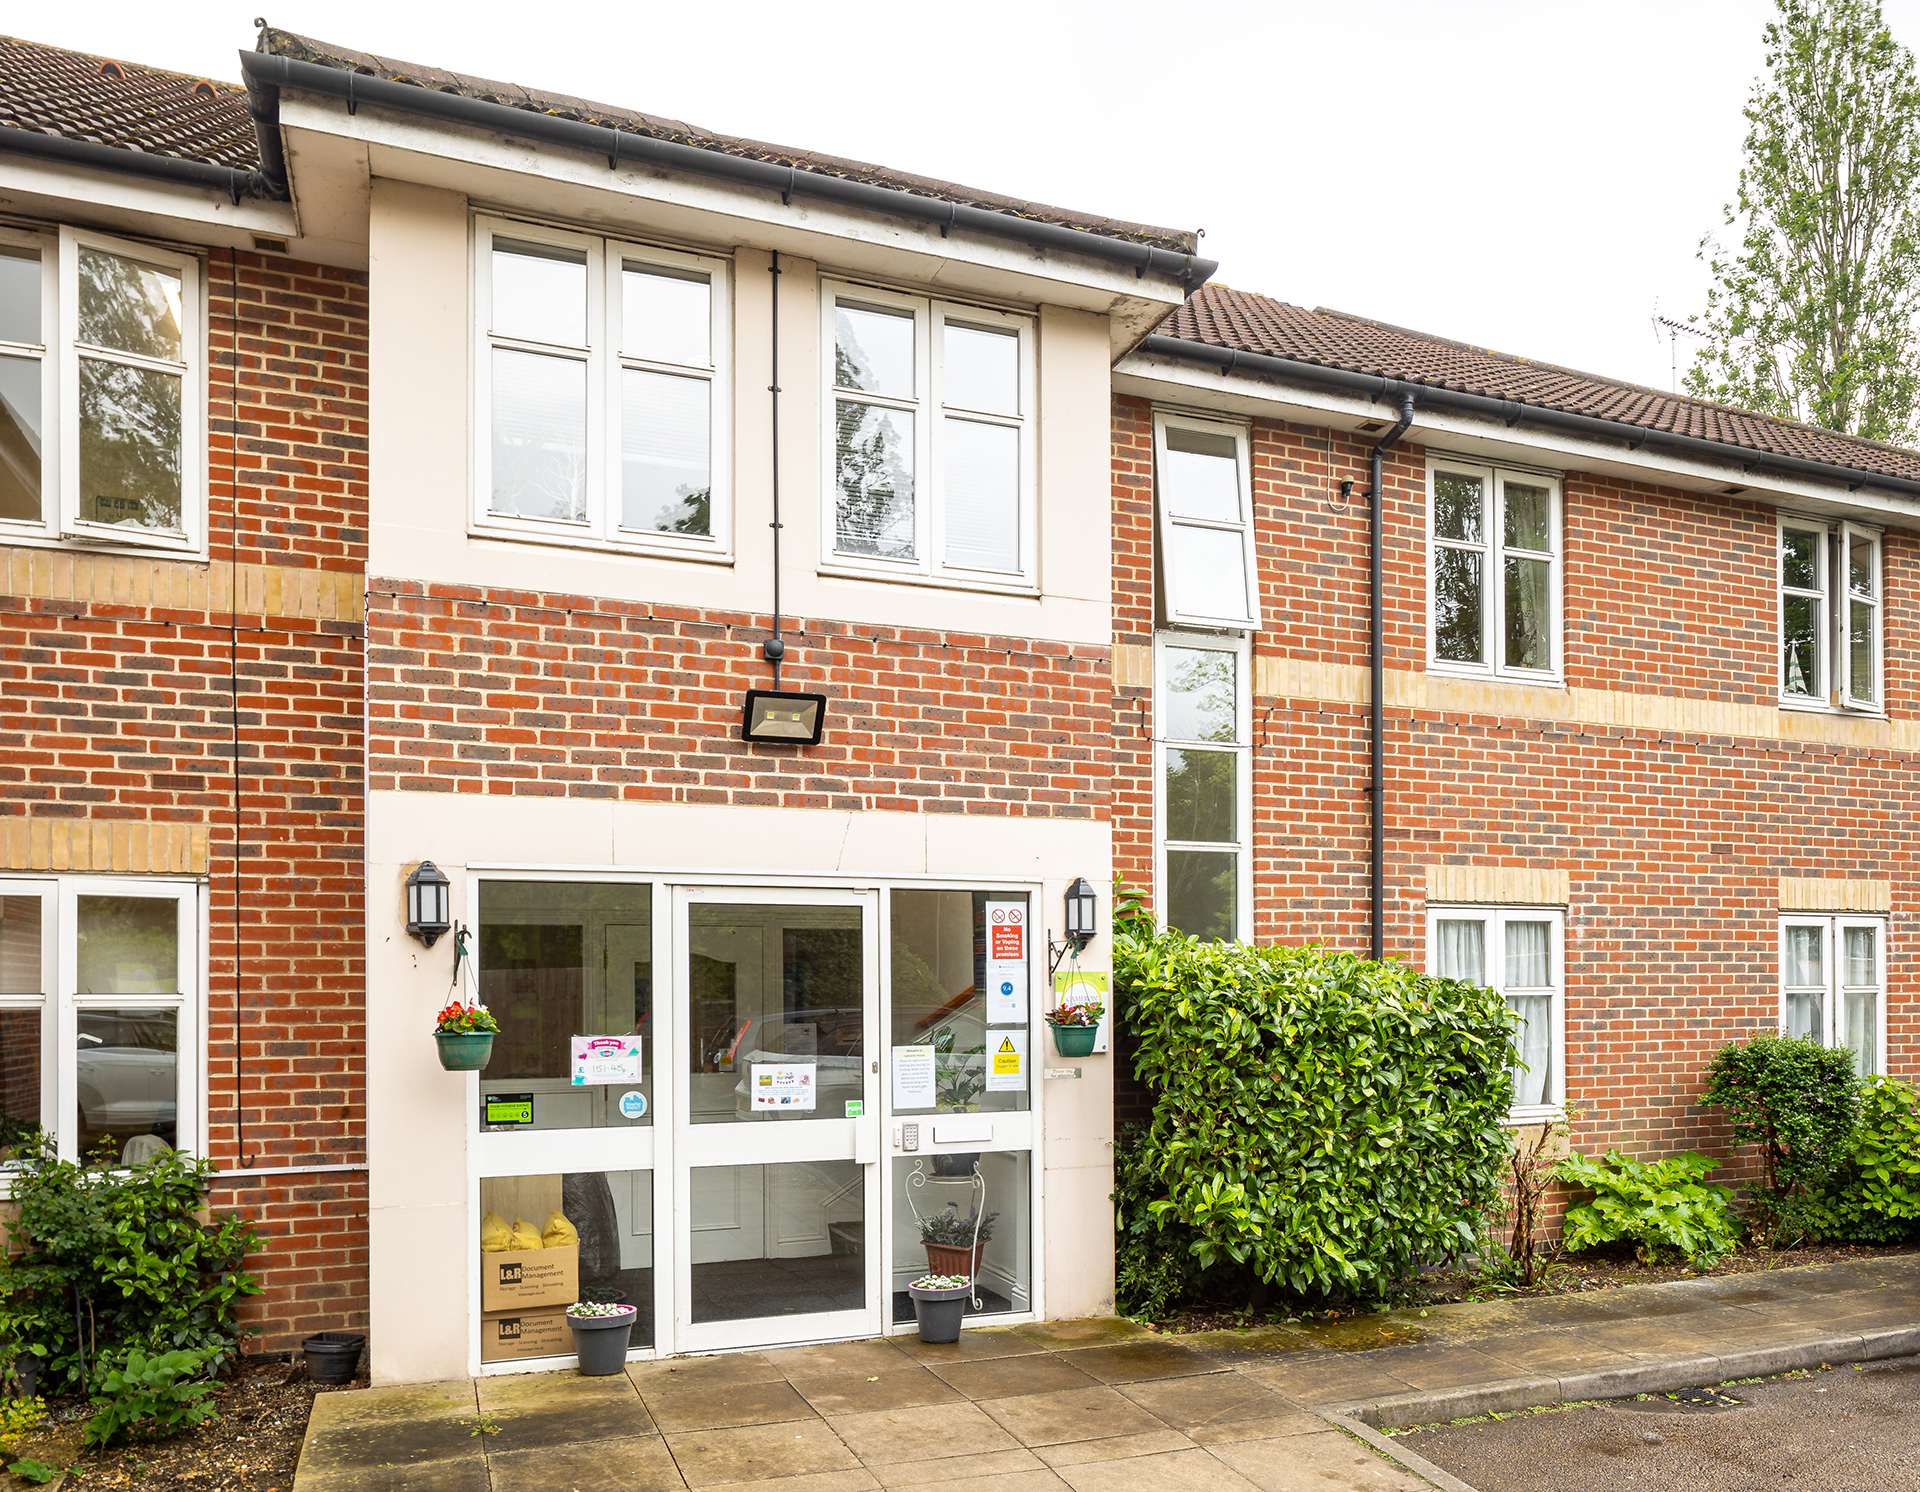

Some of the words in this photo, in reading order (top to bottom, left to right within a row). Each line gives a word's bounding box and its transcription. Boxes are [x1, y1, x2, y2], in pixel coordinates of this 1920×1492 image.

[500, 1267, 522, 1280] L&R
[522, 1264, 554, 1272] Document
[522, 1270, 564, 1279] Management
[500, 1322, 520, 1335] L&R
[520, 1326, 562, 1335] Management
